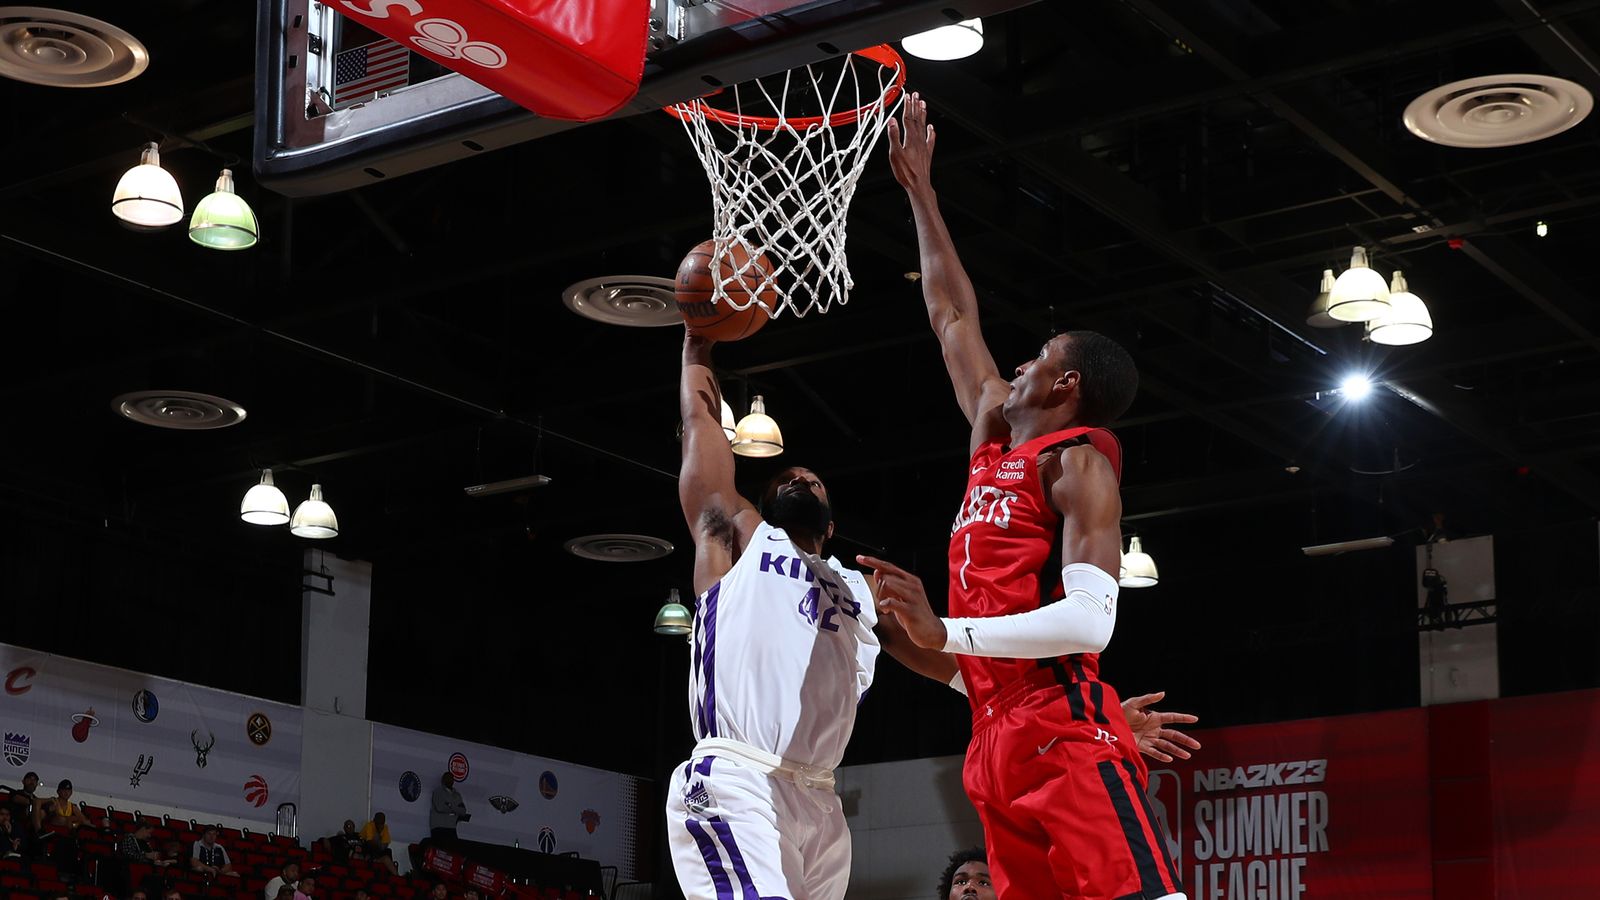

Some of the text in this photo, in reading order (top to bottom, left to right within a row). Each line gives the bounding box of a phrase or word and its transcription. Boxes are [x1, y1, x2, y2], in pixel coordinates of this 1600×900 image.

[995, 468, 1025, 480] karma
[1001, 458, 1025, 470] credit
[951, 486, 1018, 538] CKETS
[959, 532, 971, 591] 1
[3, 743, 30, 756] KINGS
[1194, 760, 1328, 793] NBA2K23
[1193, 791, 1329, 860] SUMMER
[1194, 857, 1307, 900] LEAGUE
